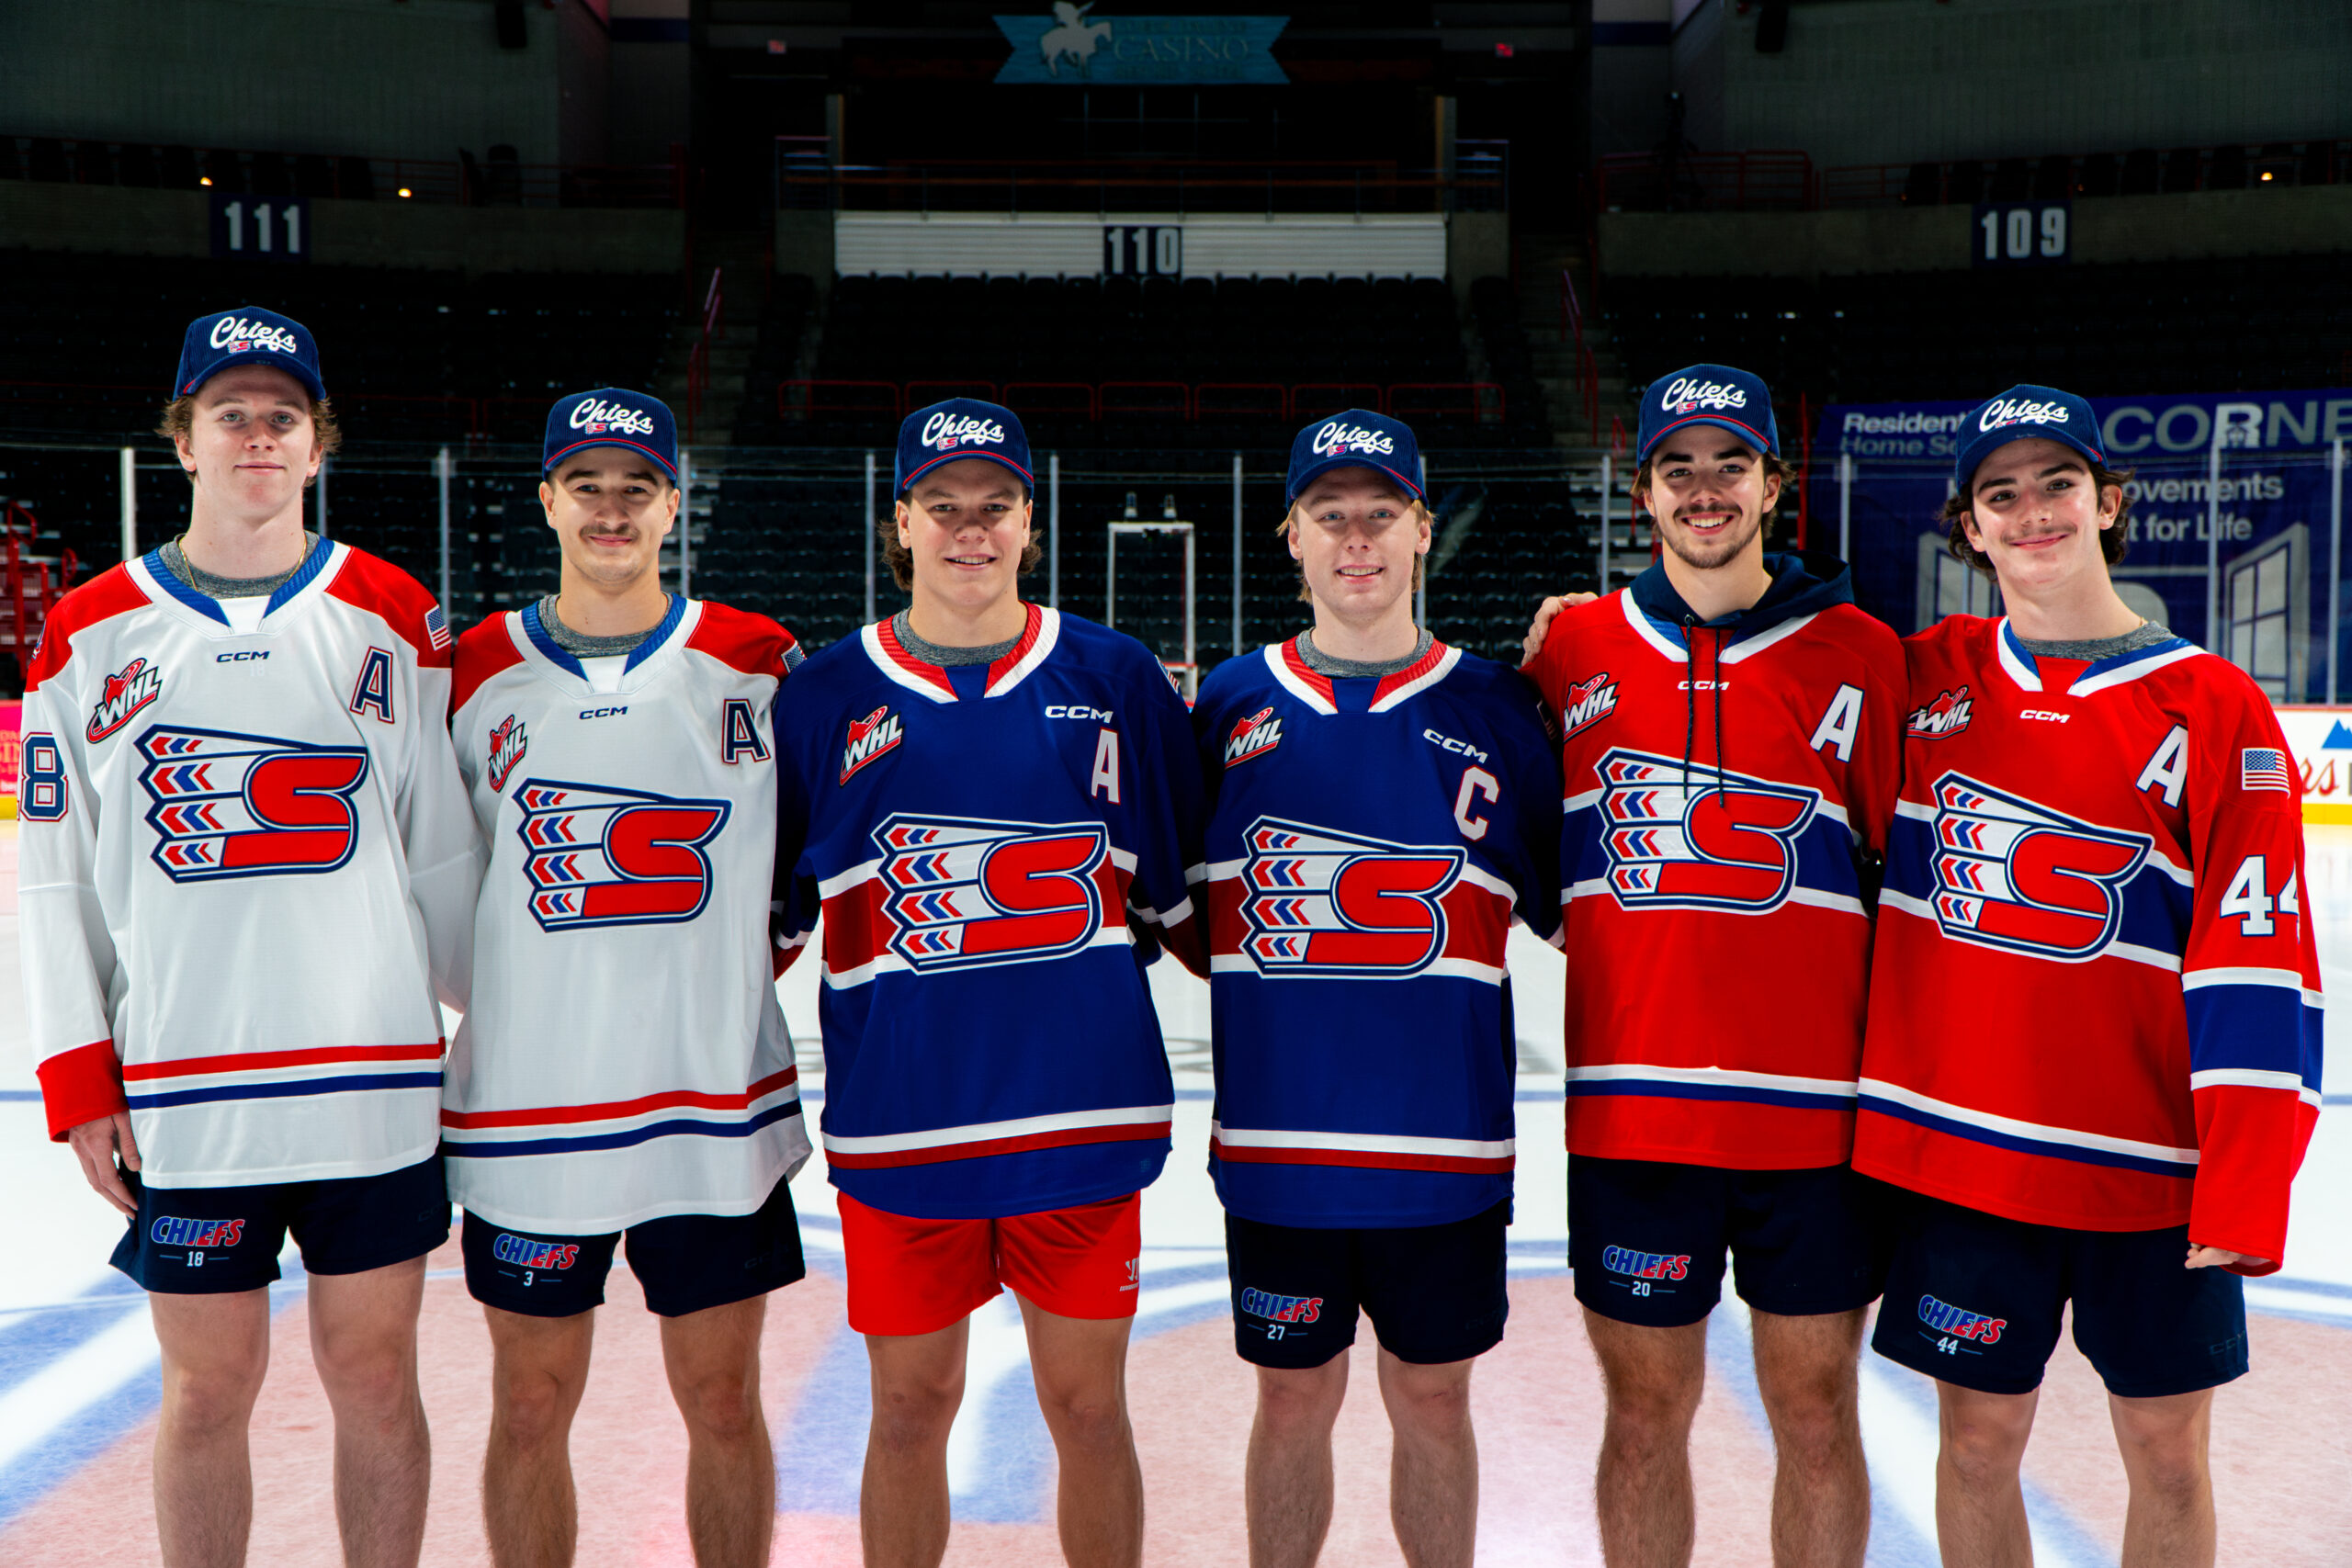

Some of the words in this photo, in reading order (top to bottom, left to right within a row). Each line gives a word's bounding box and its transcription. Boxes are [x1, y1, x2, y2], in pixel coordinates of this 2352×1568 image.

[1114, 36, 1250, 62] CASINO
[224, 201, 300, 254] 111
[1981, 207, 2065, 259] 109
[1108, 228, 1179, 274] 110
[210, 316, 296, 354] Chiefs
[1662, 378, 1746, 411] Chiefs
[570, 398, 653, 434] Chiefs
[922, 412, 1004, 446] Chiefs
[1979, 399, 2069, 432] Chiefs
[1313, 422, 1393, 455] Chiefs
[1840, 434, 1926, 456] Home
[2120, 472, 2285, 503] ovements
[2145, 513, 2190, 542] for
[2196, 511, 2253, 542] Life
[216, 650, 270, 662] CCM
[96, 666, 163, 730] WHL
[349, 646, 395, 724] A
[1678, 680, 1730, 691] CCM
[579, 705, 628, 720] CCM
[1045, 705, 1114, 724] CCM
[1564, 682, 1619, 732] WHL
[1809, 682, 1864, 763] A
[1914, 699, 1973, 733] WHL
[2019, 709, 2070, 724] CCM
[722, 699, 771, 764] A
[843, 714, 903, 773] WHL
[1225, 717, 1283, 763] WHL
[1423, 728, 1488, 763] CCM
[489, 722, 528, 782] WHL
[1091, 727, 1121, 806] A
[2135, 723, 2188, 809] A
[17, 731, 68, 822] 8
[1453, 764, 1501, 842] C
[151, 1215, 245, 1247] CHIEFS
[187, 1251, 204, 1267] 18
[493, 1233, 580, 1269] CHIEFS
[1603, 1245, 1690, 1280] CHIEFS
[523, 1270, 534, 1286] 3
[1632, 1280, 1650, 1297] 20
[1241, 1287, 1323, 1323] CHIEFS
[1918, 1294, 2007, 1344] CHIEFS
[1267, 1324, 1285, 1340] 27
[1937, 1337, 1958, 1355] 44
